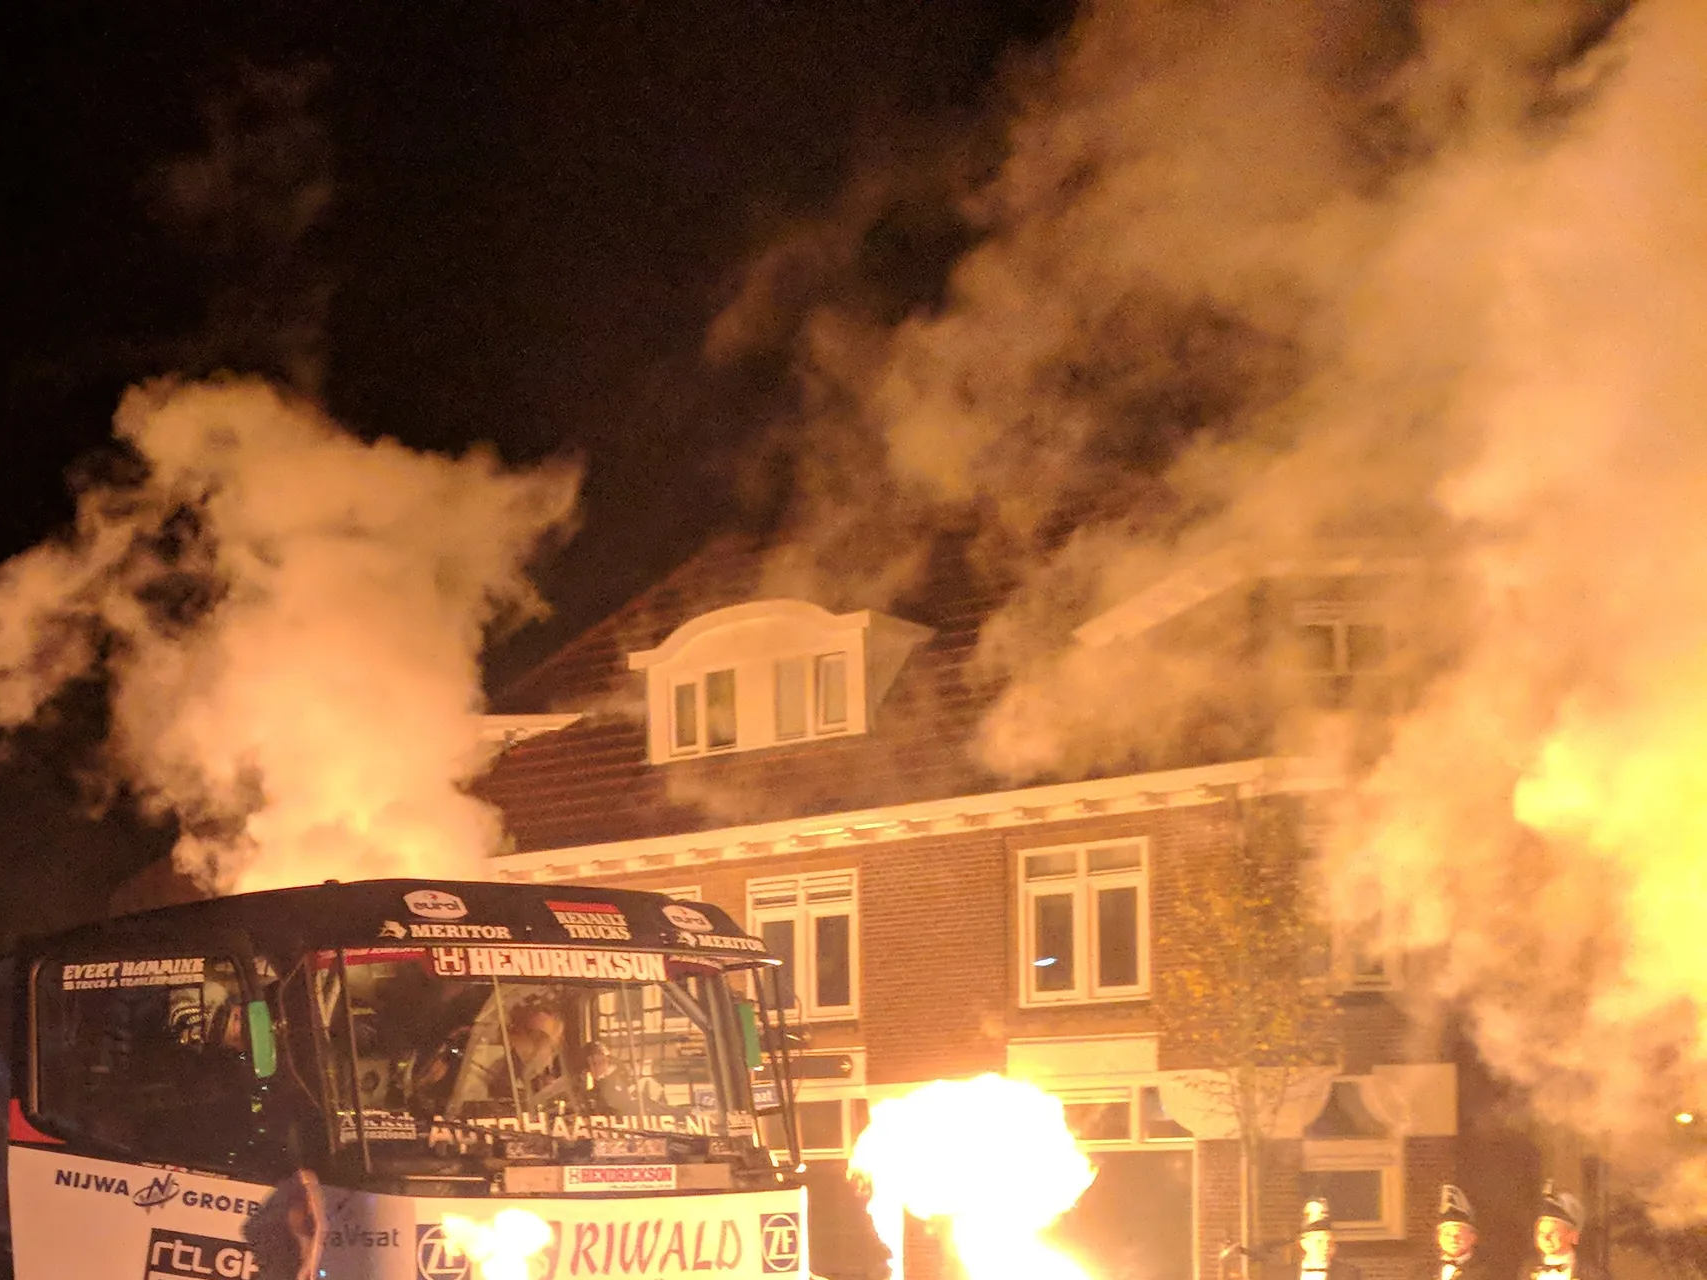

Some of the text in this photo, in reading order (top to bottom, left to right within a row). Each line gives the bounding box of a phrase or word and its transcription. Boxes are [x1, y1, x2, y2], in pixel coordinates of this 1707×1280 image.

[553, 911, 628, 926] RENAULT
[409, 924, 513, 939] MERITOR
[563, 924, 632, 940] TRUCKS
[697, 934, 767, 952] MERITOR
[63, 958, 205, 980] EVERT HAMMINK
[468, 948, 667, 981] HENDRICKSON
[54, 1169, 130, 1197] NIJWA
[581, 1168, 673, 1182] HENDRICKSON
[569, 1218, 743, 1276] RIWALD
